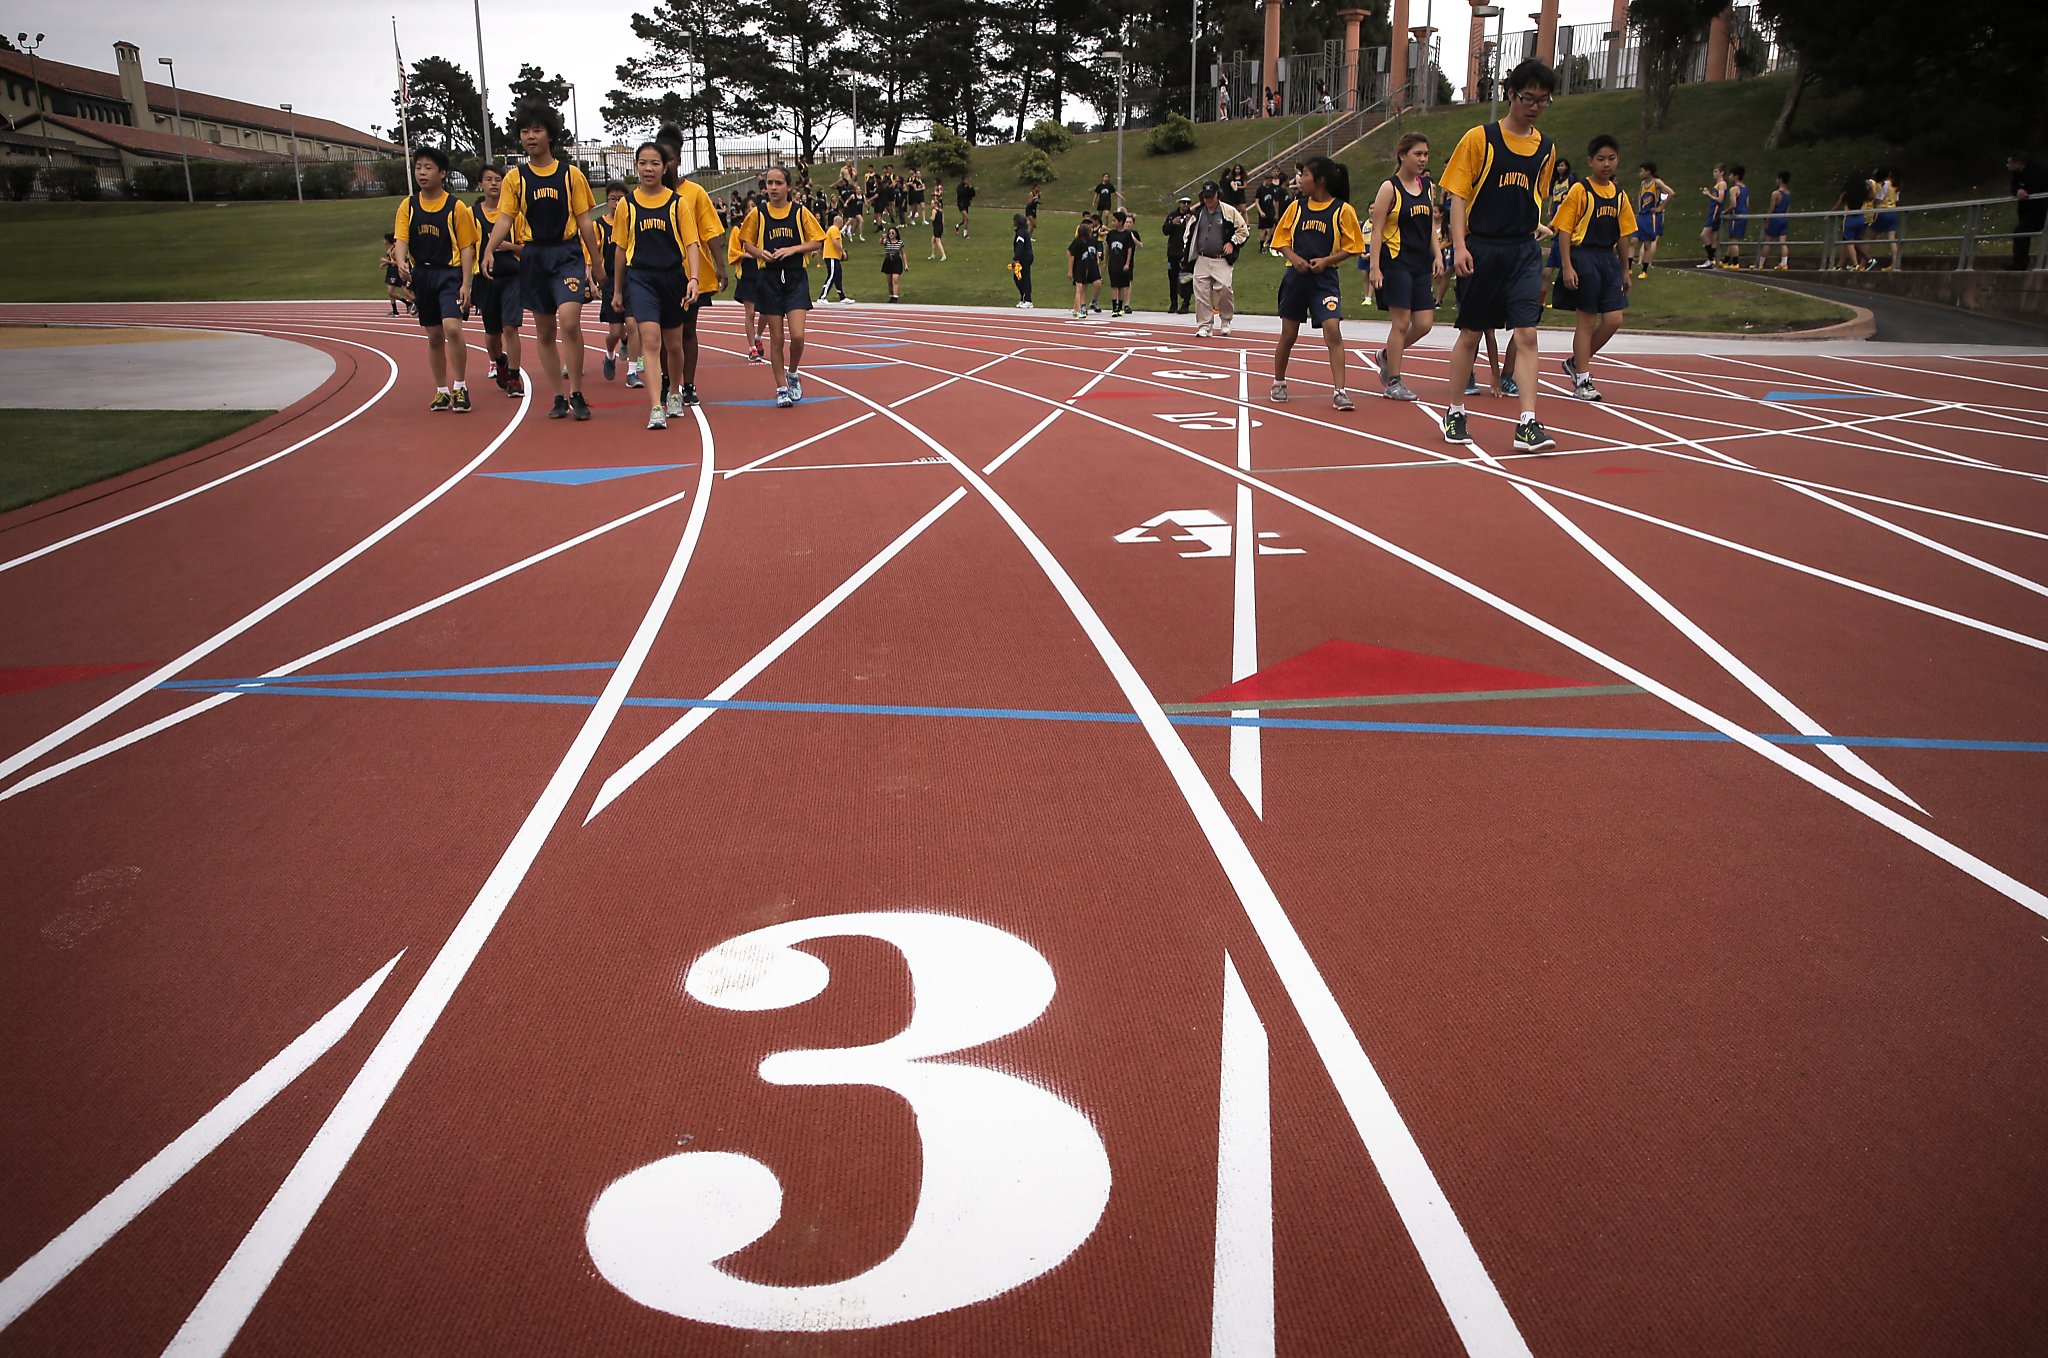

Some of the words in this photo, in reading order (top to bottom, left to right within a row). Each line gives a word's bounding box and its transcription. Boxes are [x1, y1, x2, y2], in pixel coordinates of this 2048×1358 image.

[1499, 172, 1528, 190] LAWTON
[533, 187, 558, 200] LAWTON
[1410, 205, 1430, 217] LAWTON
[1597, 206, 1617, 218] LAWTON
[418, 224, 440, 237] LAWTON
[640, 218, 666, 231] LAWTON
[1302, 220, 1327, 234] LAWTON
[769, 228, 793, 240] LAWTON
[1113, 509, 1307, 558] 4
[585, 910, 1112, 1332] 3
